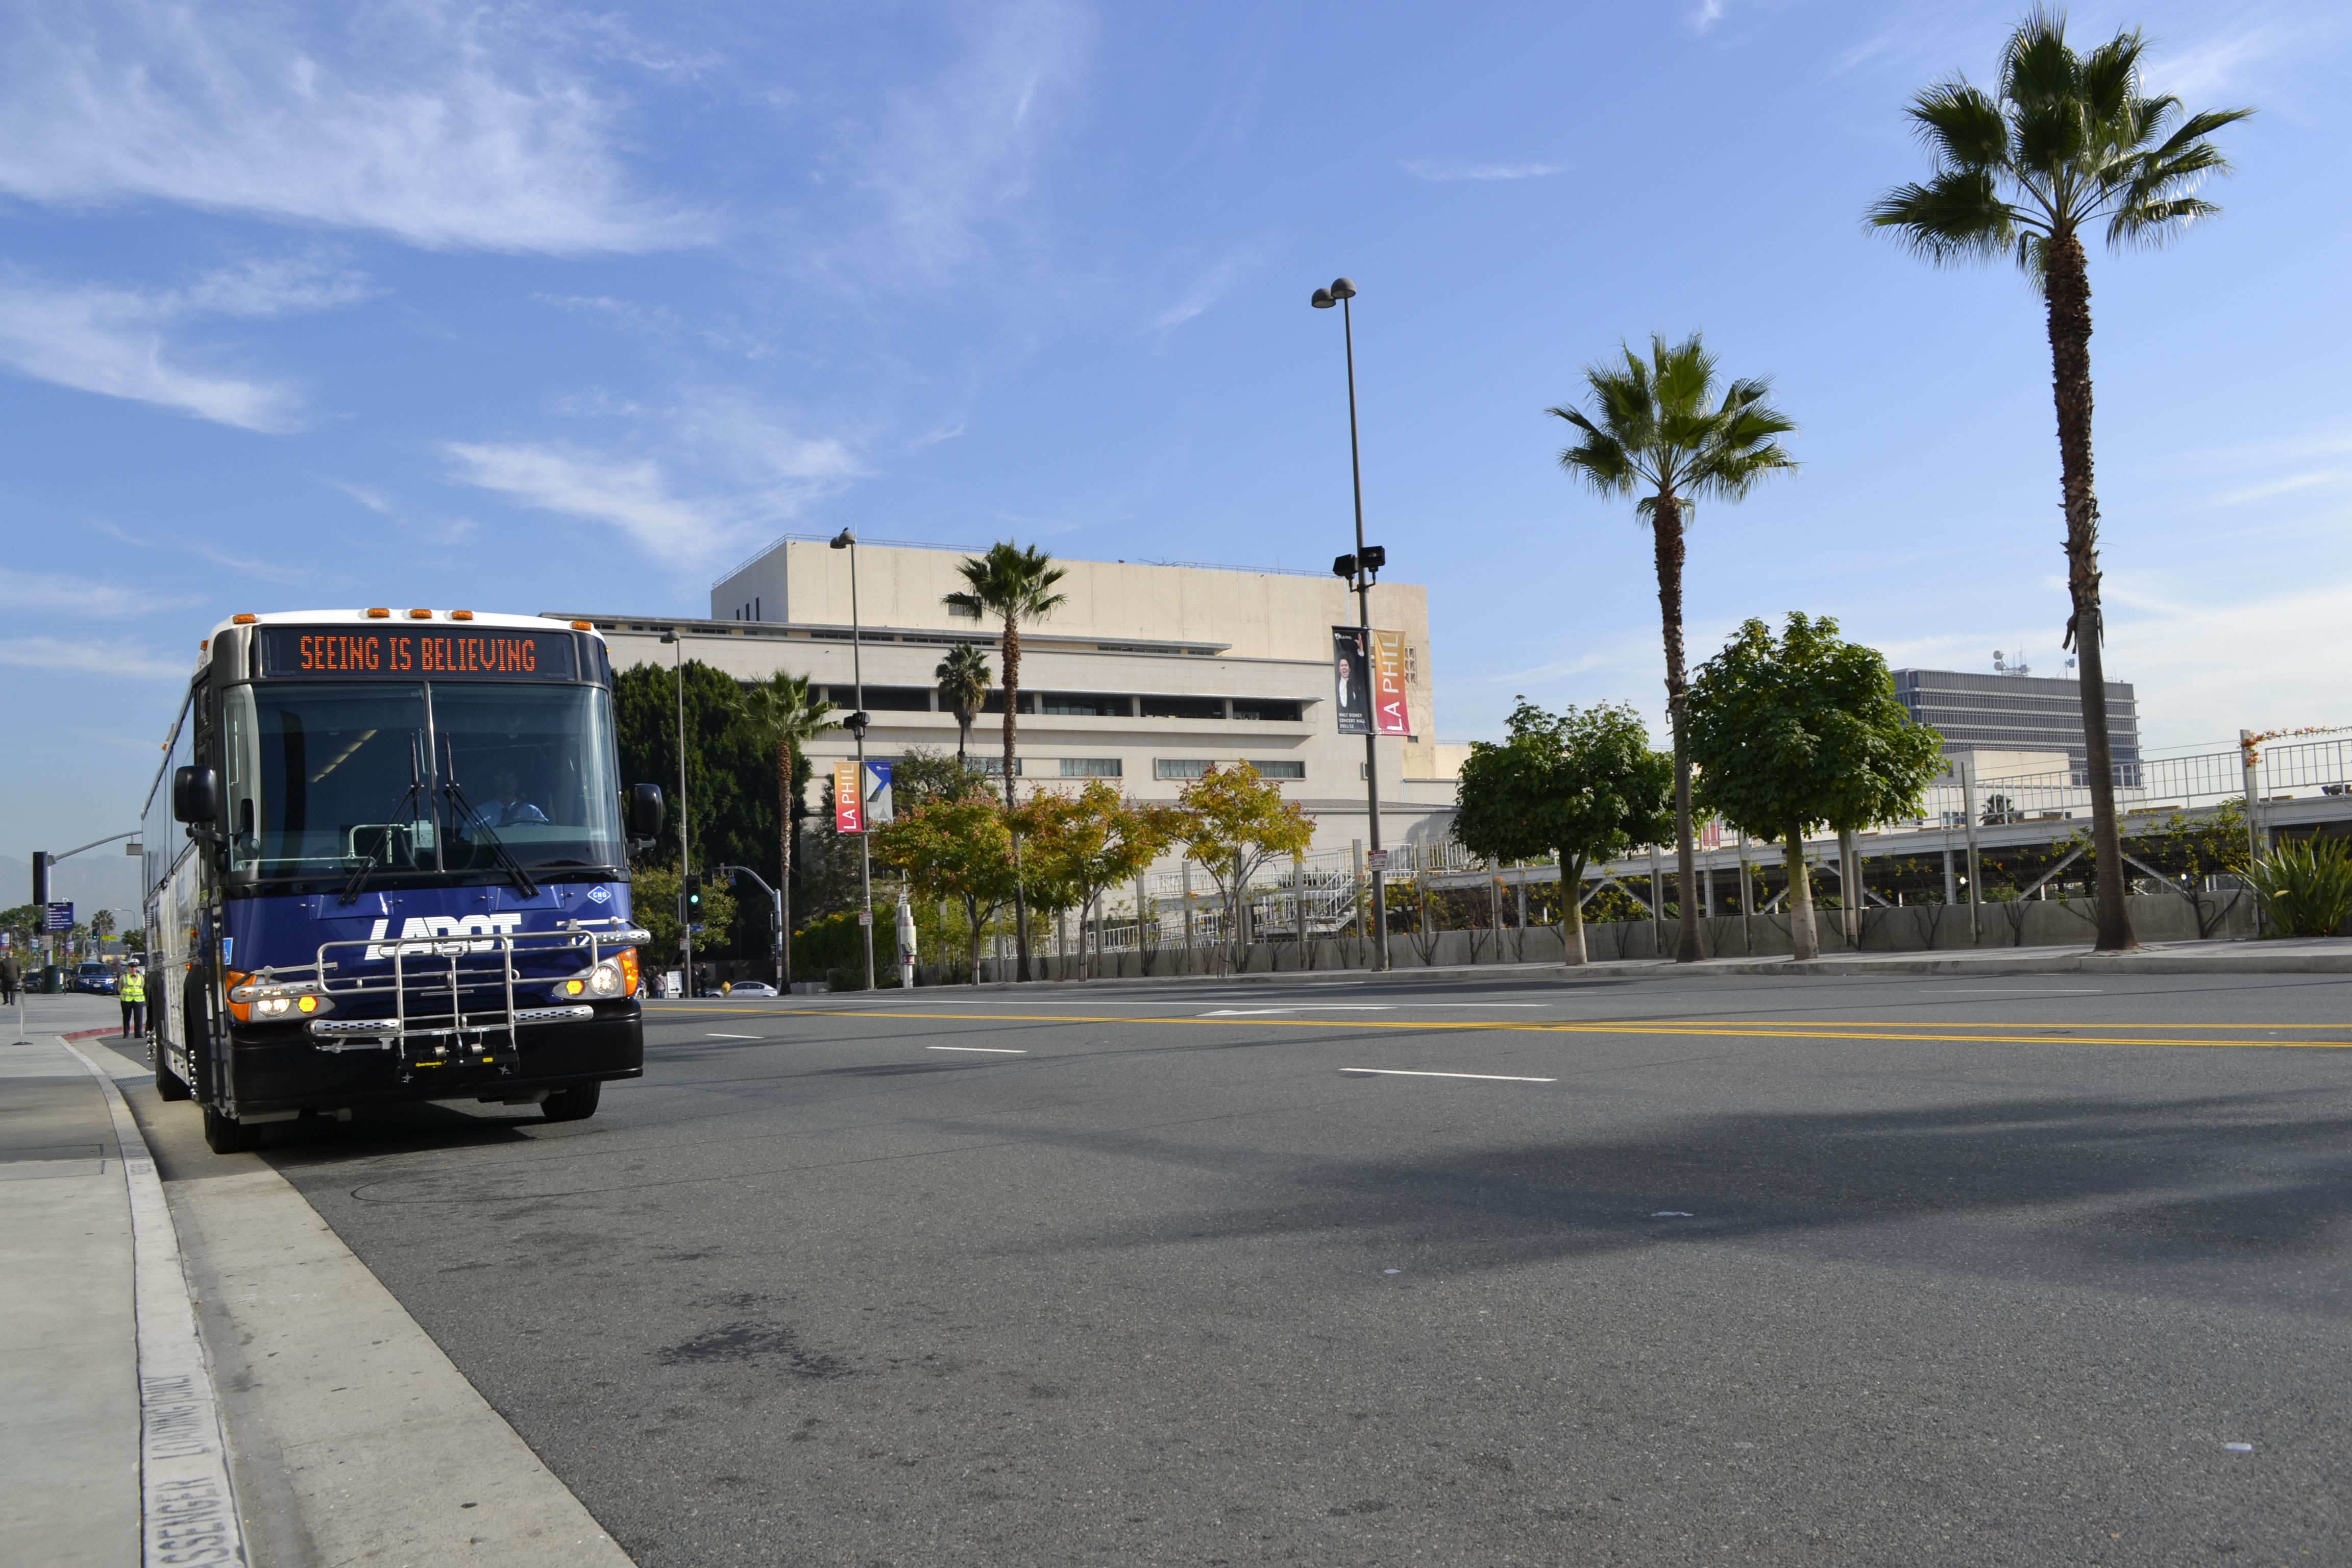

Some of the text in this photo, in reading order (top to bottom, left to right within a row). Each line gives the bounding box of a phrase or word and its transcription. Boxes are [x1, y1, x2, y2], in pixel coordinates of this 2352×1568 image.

[300, 636, 535, 672] SEEING IS BELIEVING
[1382, 634, 1399, 693] PHIL
[1383, 701, 1403, 731] LA
[841, 764, 856, 829] LA PHIL
[364, 913, 522, 961] LADOT
[142, 1375, 230, 1568] SSENGER LOADING ONLY
